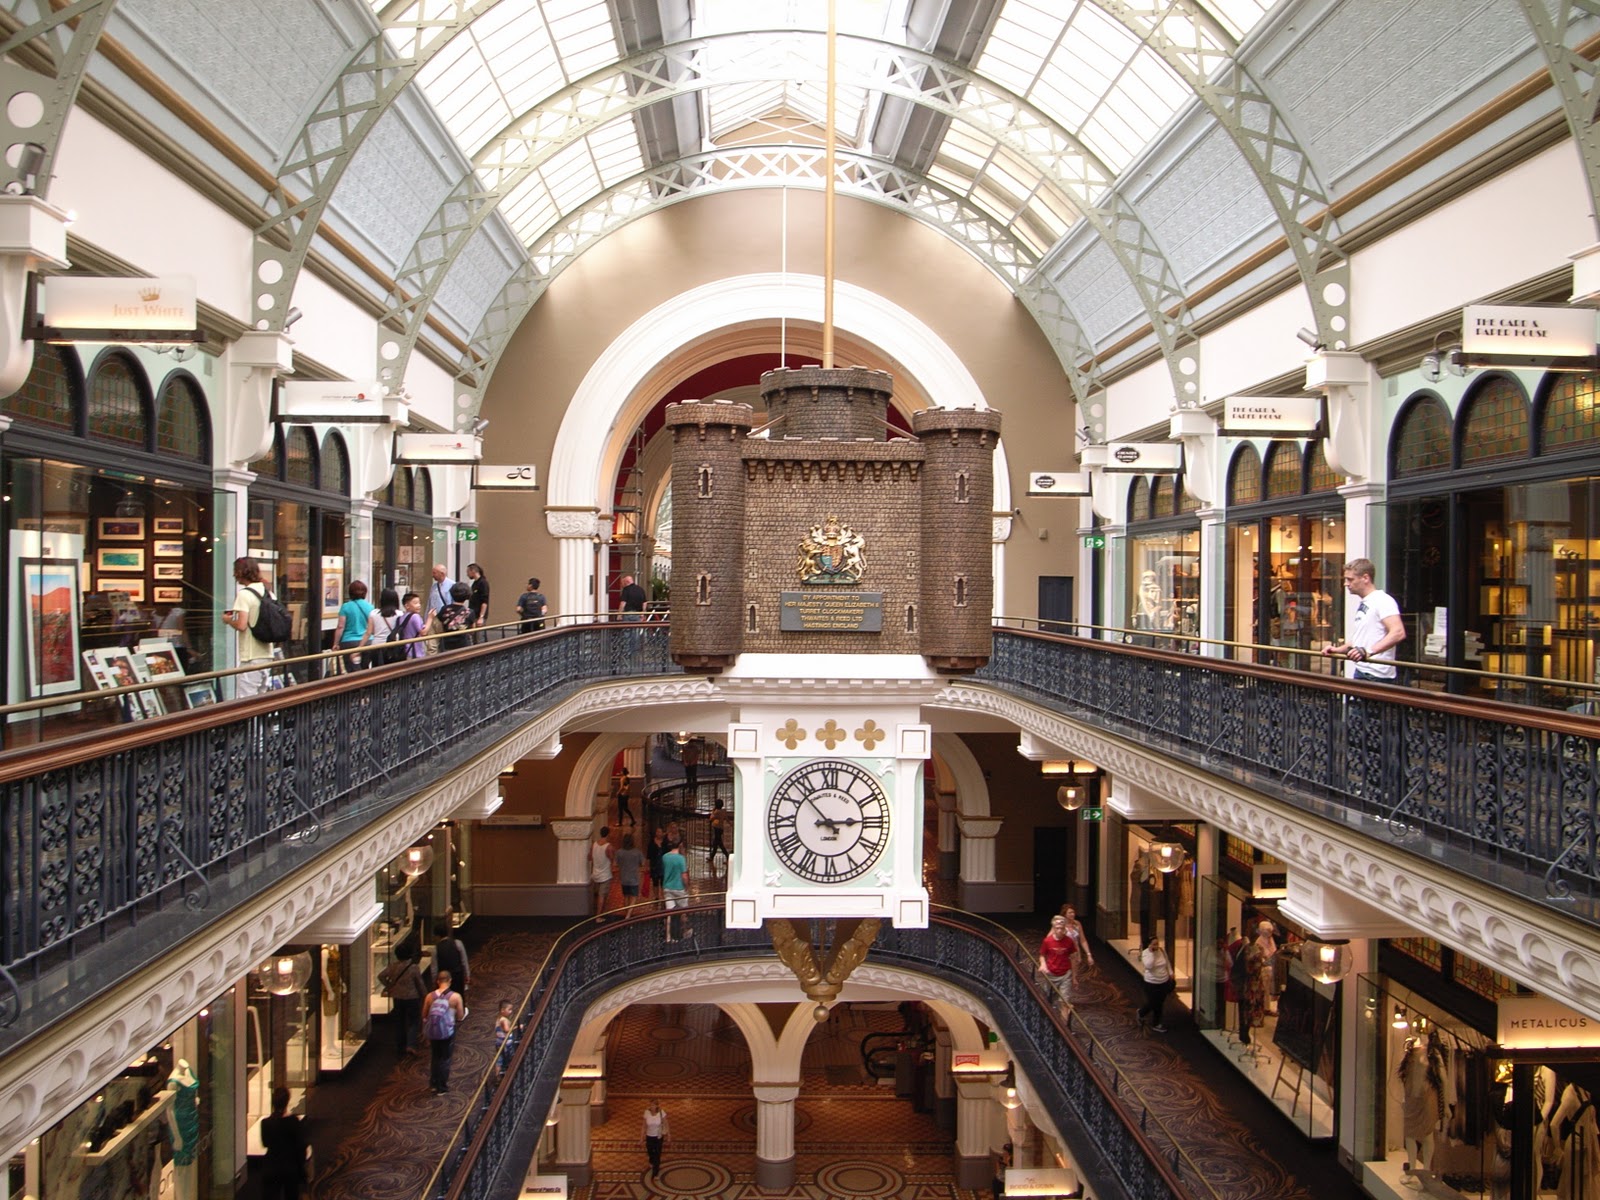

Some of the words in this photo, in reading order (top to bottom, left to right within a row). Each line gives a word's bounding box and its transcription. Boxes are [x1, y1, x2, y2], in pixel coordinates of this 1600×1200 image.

[113, 304, 140, 317] JUST
[144, 304, 184, 317] WHITE
[1476, 318, 1495, 326] THE
[1499, 319, 1527, 327] CARD
[1532, 320, 1539, 328] &
[1475, 328, 1511, 336] PAPER
[1514, 329, 1548, 338] HOUSE
[838, 794, 850, 804] REED
[1510, 1018, 1587, 1029] METALICUS
